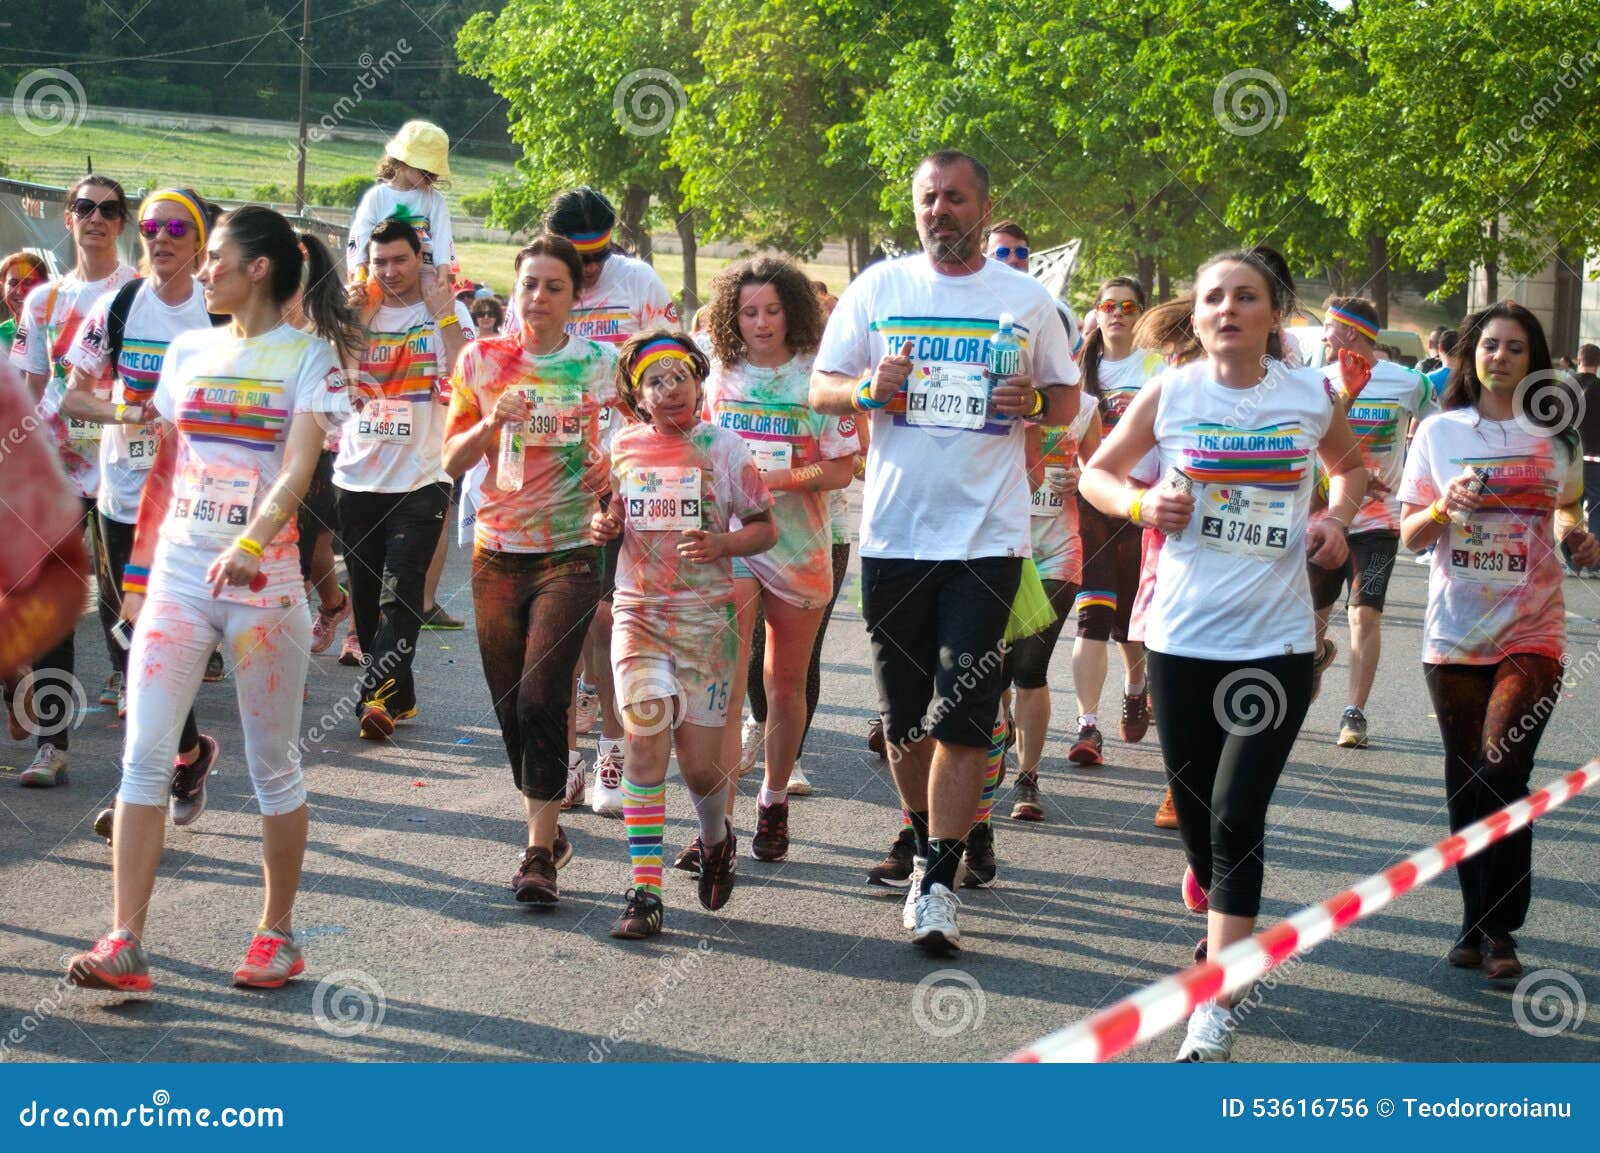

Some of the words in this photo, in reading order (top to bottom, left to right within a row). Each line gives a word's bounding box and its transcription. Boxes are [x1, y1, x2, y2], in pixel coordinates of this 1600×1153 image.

[566, 320, 594, 337] OLOR
[595, 319, 619, 335] RUN
[918, 336, 979, 363] COLOR
[120, 350, 140, 370] THE
[931, 366, 943, 374] THE
[206, 388, 245, 406] COLOR
[931, 393, 962, 414] 4272
[373, 421, 395, 436] 4592
[529, 415, 558, 434] 3390
[718, 410, 732, 429] HE
[732, 412, 772, 434] COLOR
[1198, 434, 1220, 450] THE
[1221, 435, 1268, 451] COLOR
[1228, 497, 1250, 509] COLOR
[1230, 488, 1243, 499] THE
[193, 499, 224, 524] 4551
[648, 498, 676, 517] 3389
[1227, 520, 1262, 546] 3746
[1473, 551, 1504, 572] 6233
[706, 681, 729, 711] 15
